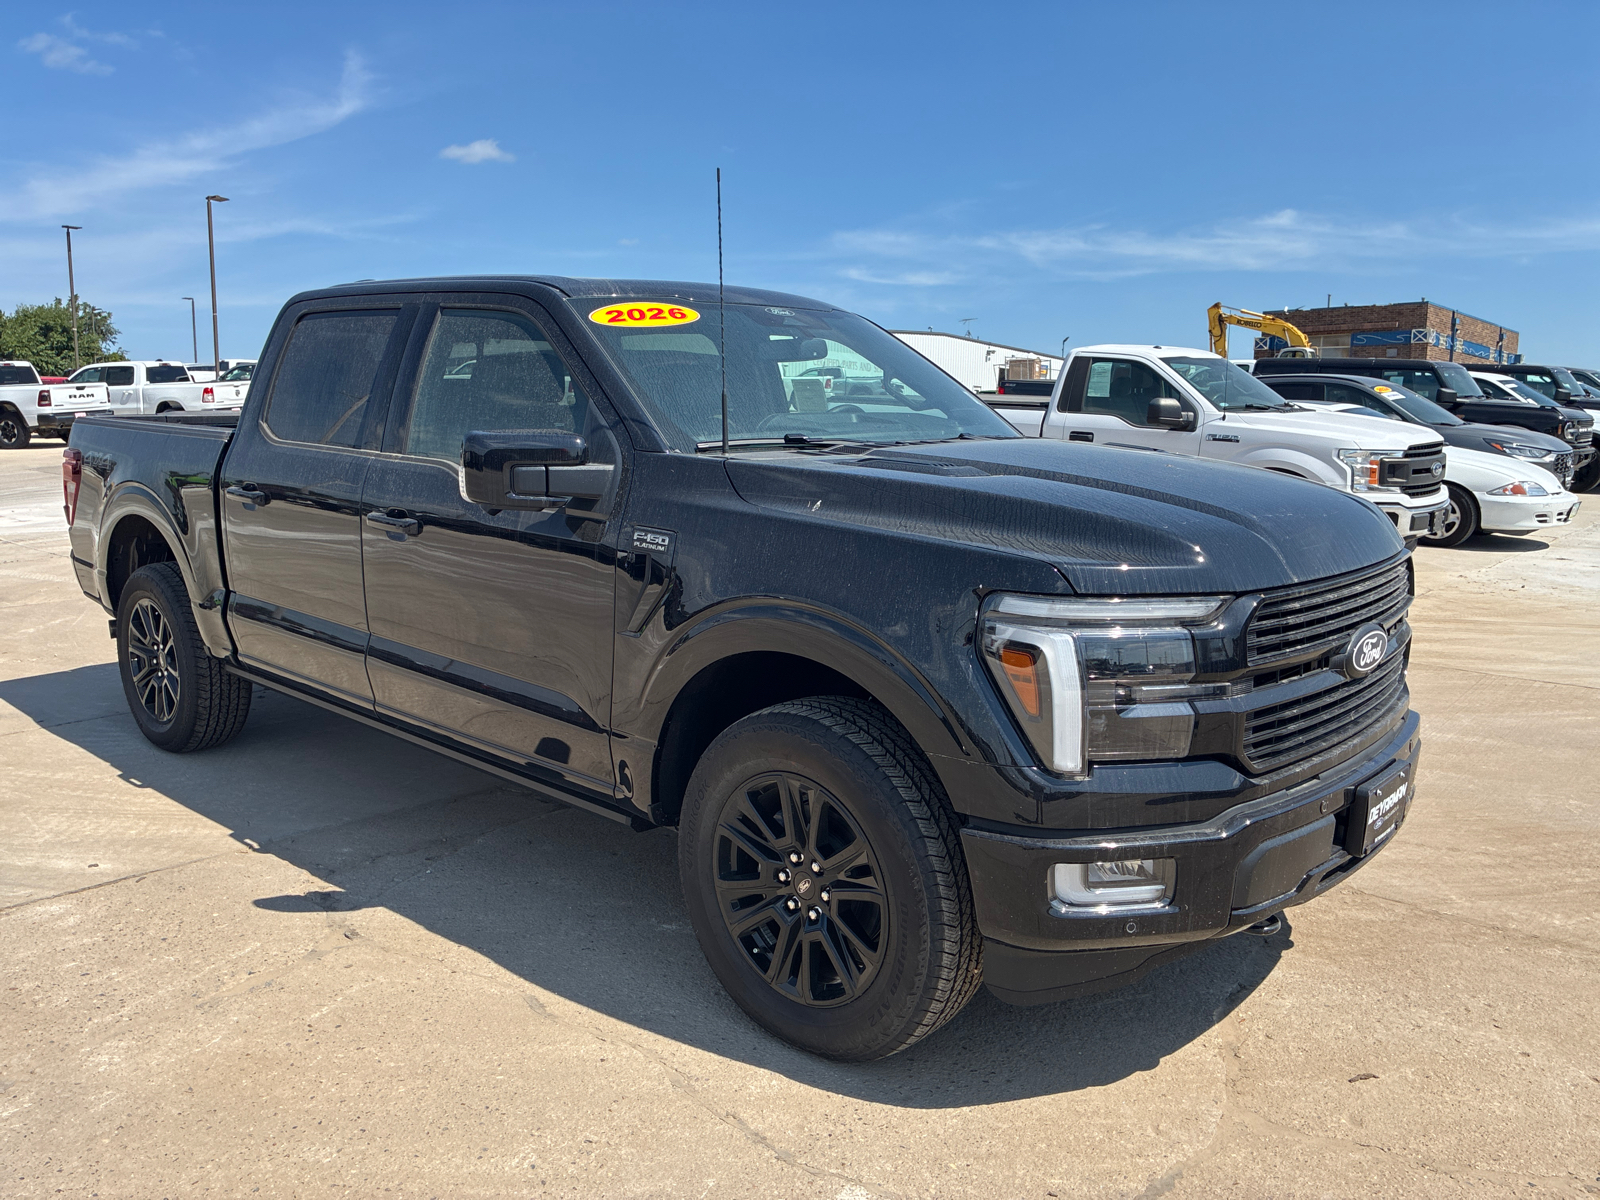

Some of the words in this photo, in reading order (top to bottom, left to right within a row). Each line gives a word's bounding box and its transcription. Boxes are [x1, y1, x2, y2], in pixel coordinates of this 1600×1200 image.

[605, 308, 688, 323] 2026
[1236, 319, 1262, 329] KOBELCO
[633, 531, 669, 546] F-150
[633, 541, 666, 552] PLATINUM
[1360, 636, 1383, 667] Ford
